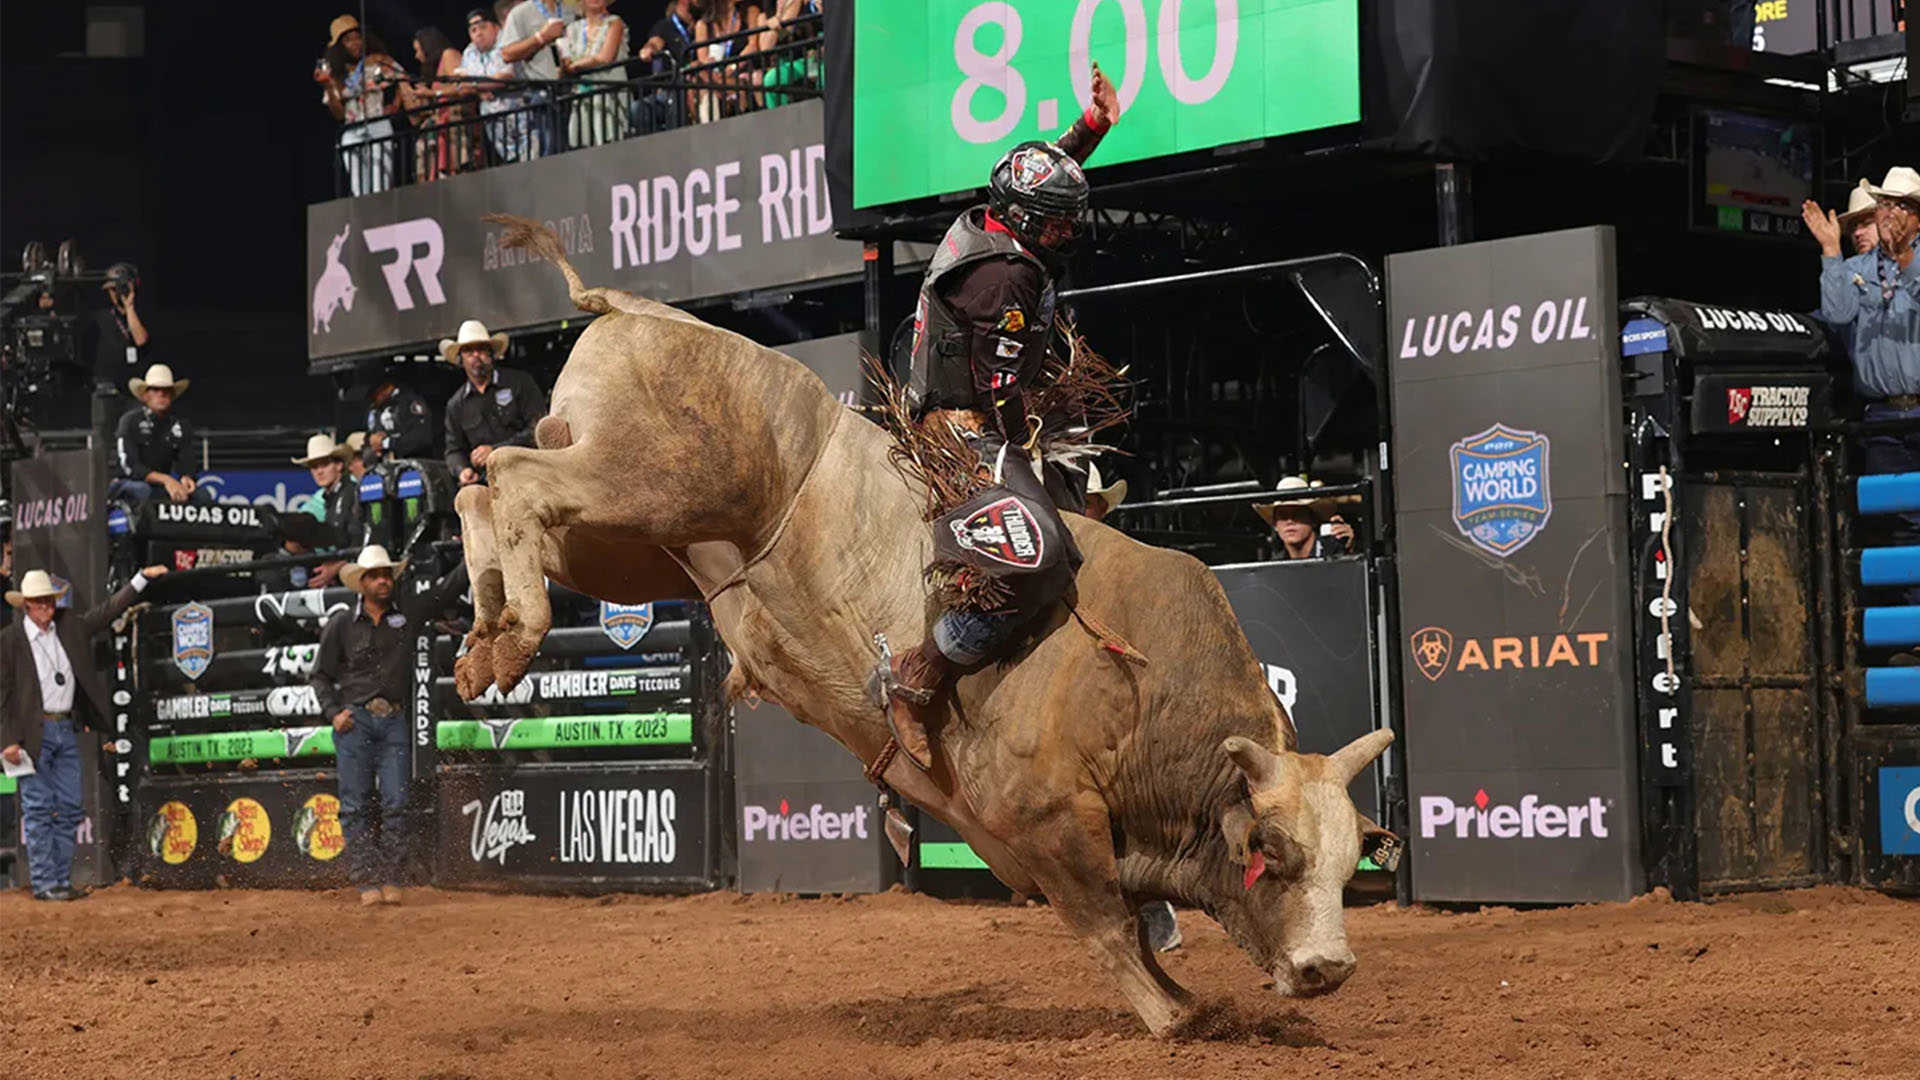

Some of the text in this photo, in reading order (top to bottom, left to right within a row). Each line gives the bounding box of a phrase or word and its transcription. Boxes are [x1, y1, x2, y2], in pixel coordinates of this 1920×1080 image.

[951, 0, 1239, 144] 8.00
[610, 161, 743, 270] RIDGE
[1400, 304, 1521, 359] LUCAS
[1695, 307, 1768, 331] LUCAS
[1751, 387, 1810, 406] TRACTOR
[1463, 458, 1536, 481] CAMPING
[1464, 477, 1537, 502] WORLD
[16, 493, 88, 530] LUCAS OIL
[158, 503, 224, 525] LUCAS
[1002, 508, 1036, 557] THUNDER
[1456, 633, 1608, 671] ARIAT
[415, 636, 431, 746] REWARDS
[539, 672, 637, 698] GAMBLER DAYS
[639, 678, 681, 691] TECOVAS
[157, 695, 210, 720] GAMBLER
[227, 738, 253, 756] 2023
[608, 720, 624, 739] TX
[635, 718, 668, 738] 2023
[462, 794, 536, 865] Vegas
[560, 788, 677, 864] LAS VEGAS
[744, 799, 868, 842] Priefert
[1419, 788, 1609, 839] Priefert
